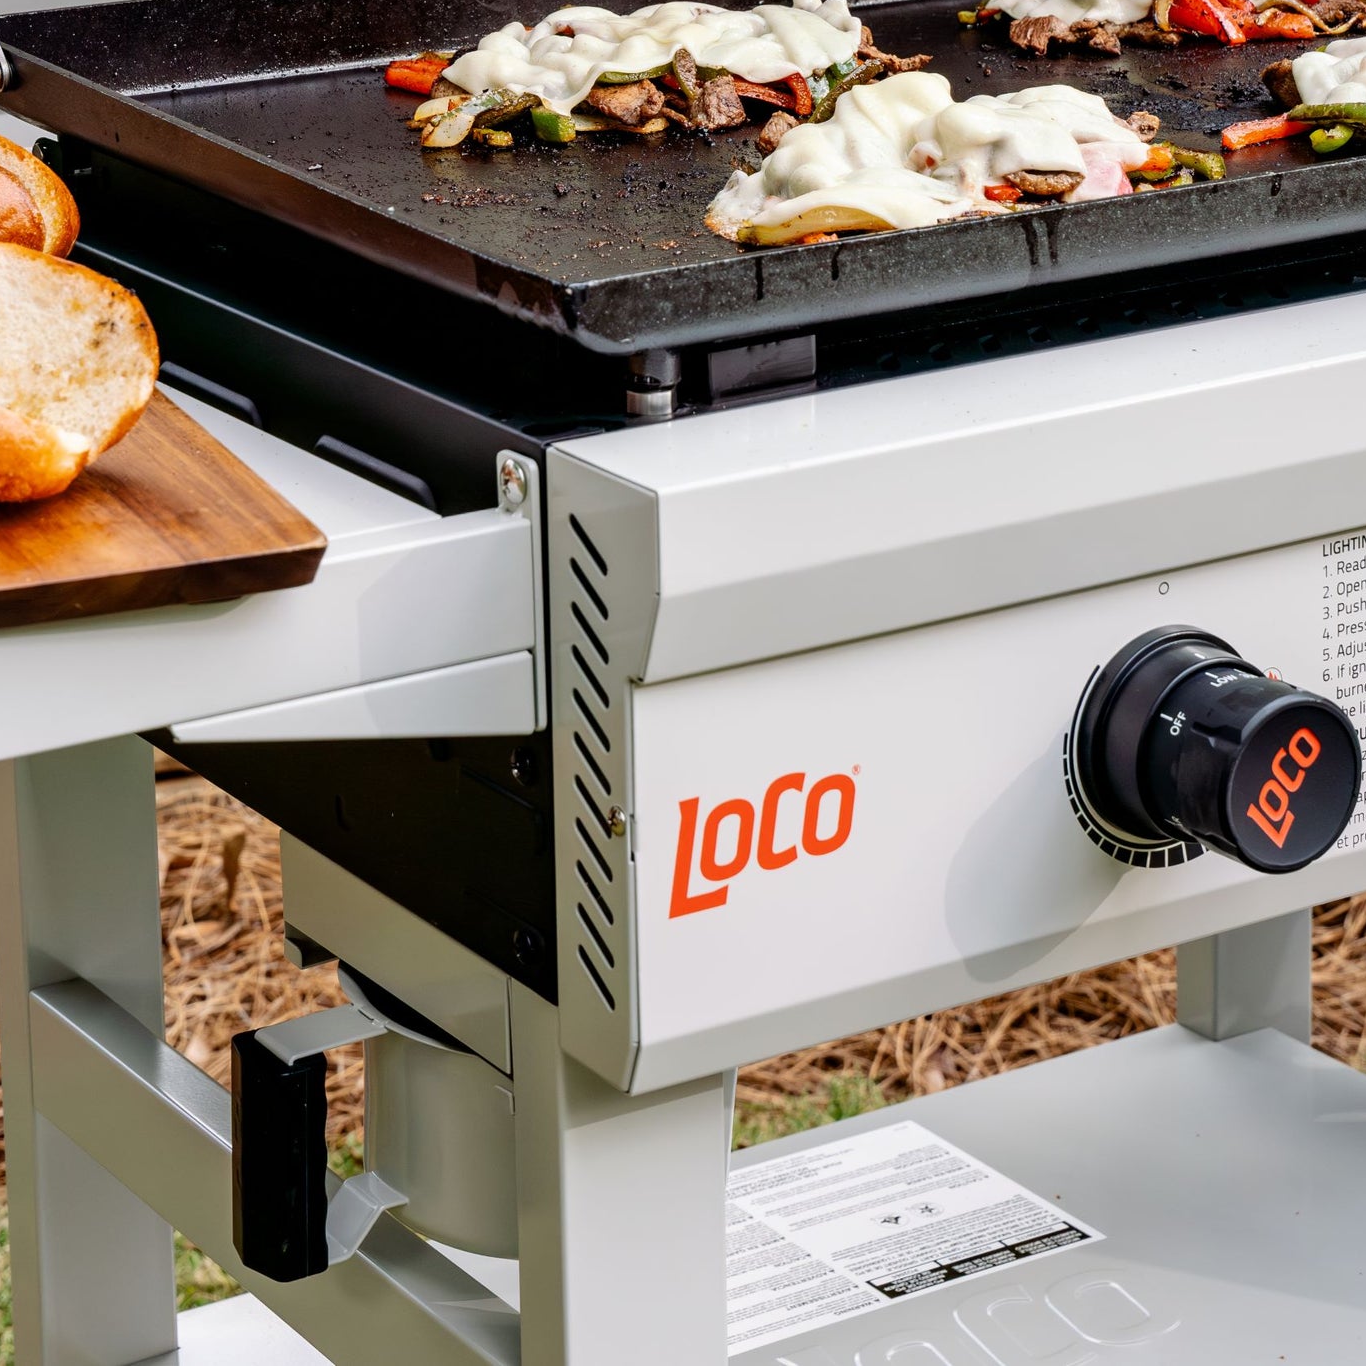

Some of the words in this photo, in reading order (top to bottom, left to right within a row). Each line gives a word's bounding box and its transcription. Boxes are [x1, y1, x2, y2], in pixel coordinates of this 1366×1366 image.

[1323, 565, 1332, 578] 1.
[1337, 555, 1366, 575] Read
[1323, 586, 1333, 599] 2.
[1337, 579, 1366, 598] Open
[1323, 606, 1332, 620] 3.
[1337, 597, 1366, 619] Push
[1323, 628, 1333, 640] 4.
[1323, 648, 1333, 662] 5.
[1210, 674, 1238, 687] LOW
[1323, 668, 1333, 682] 6.
[1337, 664, 1345, 678] If
[1342, 705, 1356, 718] he
[1170, 711, 1186, 735] OFF
[1336, 832, 1349, 849] et
[834, 1301, 872, 1315] WARNING
